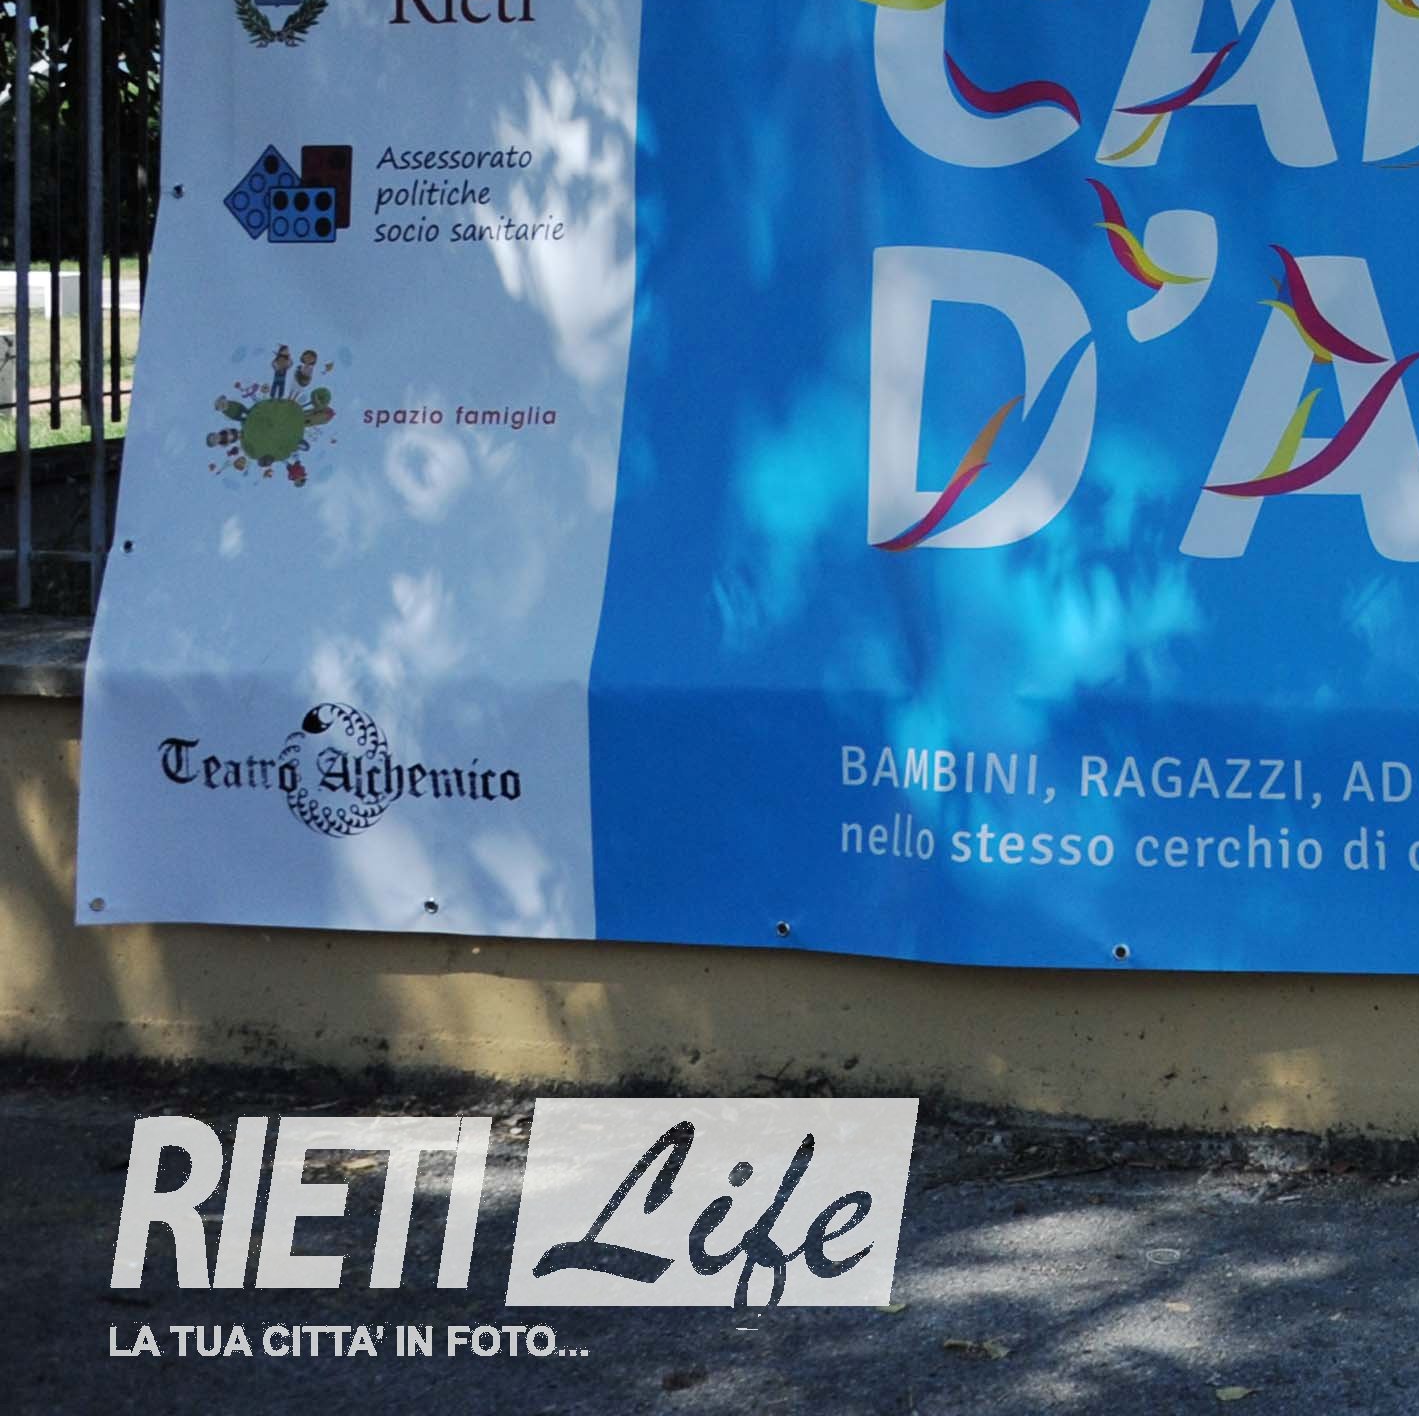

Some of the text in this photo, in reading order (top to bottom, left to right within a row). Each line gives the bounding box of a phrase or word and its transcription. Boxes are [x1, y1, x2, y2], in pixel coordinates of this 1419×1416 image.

[376, 146, 533, 170] Assessorato
[374, 181, 491, 214] politiche
[374, 216, 566, 243] socio sanitarie
[362, 404, 558, 429] spazio famiglia
[158, 737, 522, 801] Teatro Alchemico
[840, 745, 1057, 803] BAMBINI,
[1080, 755, 1323, 807] RAGAZZI,
[840, 813, 935, 863] nello
[951, 823, 1114, 868] stesso
[1136, 826, 1323, 872] cerchio
[1344, 828, 1388, 871] di
